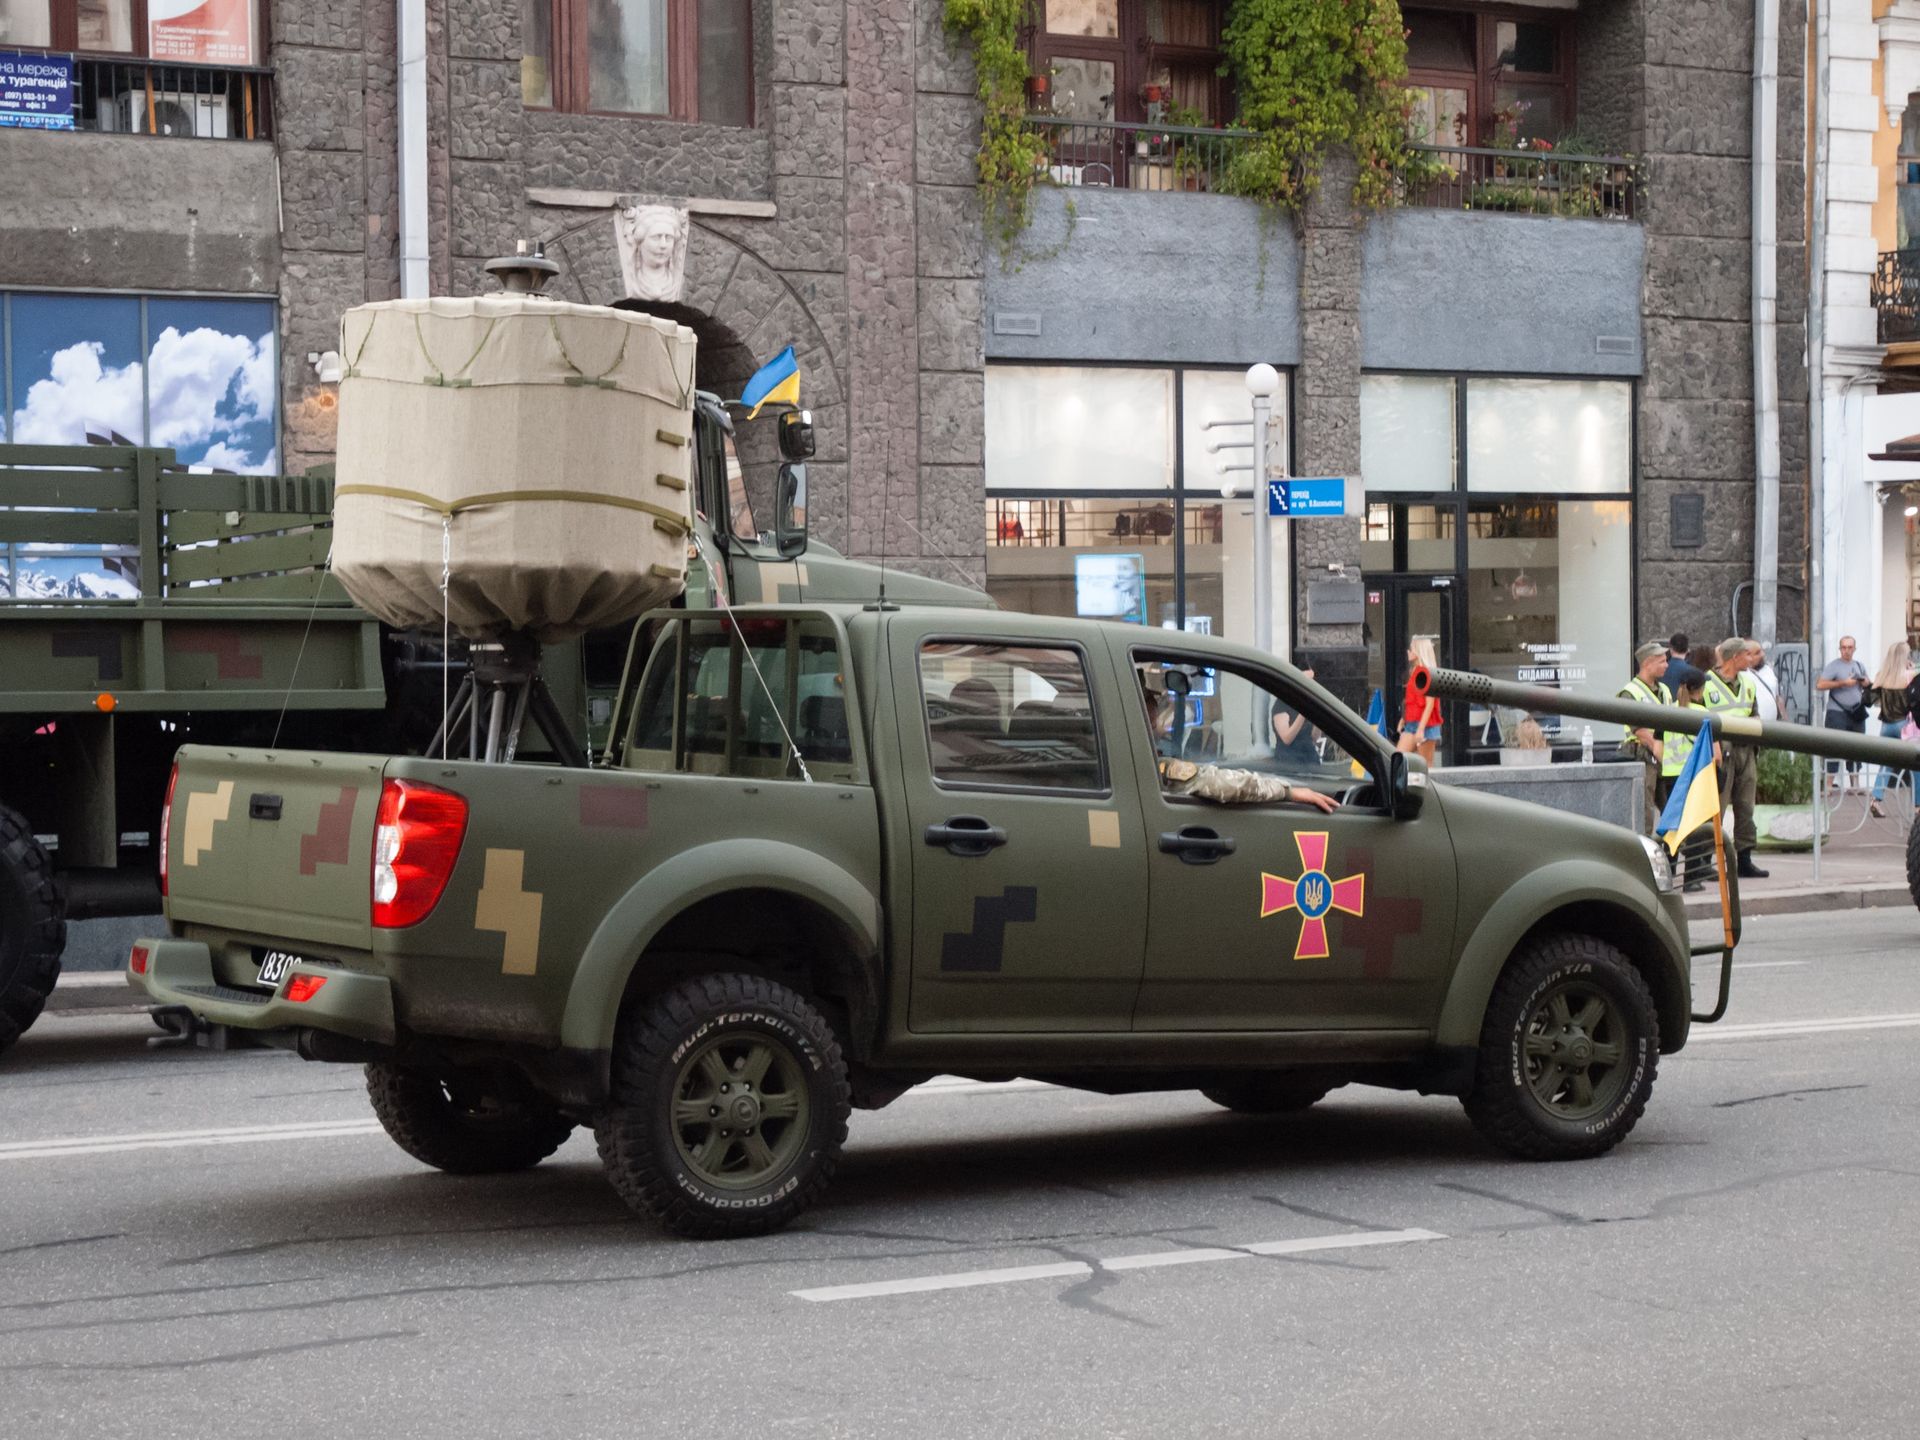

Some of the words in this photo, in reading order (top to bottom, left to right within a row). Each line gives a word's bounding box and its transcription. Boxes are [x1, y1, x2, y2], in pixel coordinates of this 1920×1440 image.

[8, 76, 67, 89] турагенцій
[17, 64, 68, 77] мережа
[1518, 669, 1555, 682] СНІДАНКИ
[1556, 669, 1566, 680] ТА
[1567, 668, 1586, 680] КАВА
[671, 1012, 796, 1064] Mud-Terrain
[1512, 971, 1561, 1086] Mud-Terrain
[1564, 963, 1592, 975] T/A
[1585, 1037, 1647, 1135] BFGoodrich
[677, 1173, 799, 1208] BFGoodrich
